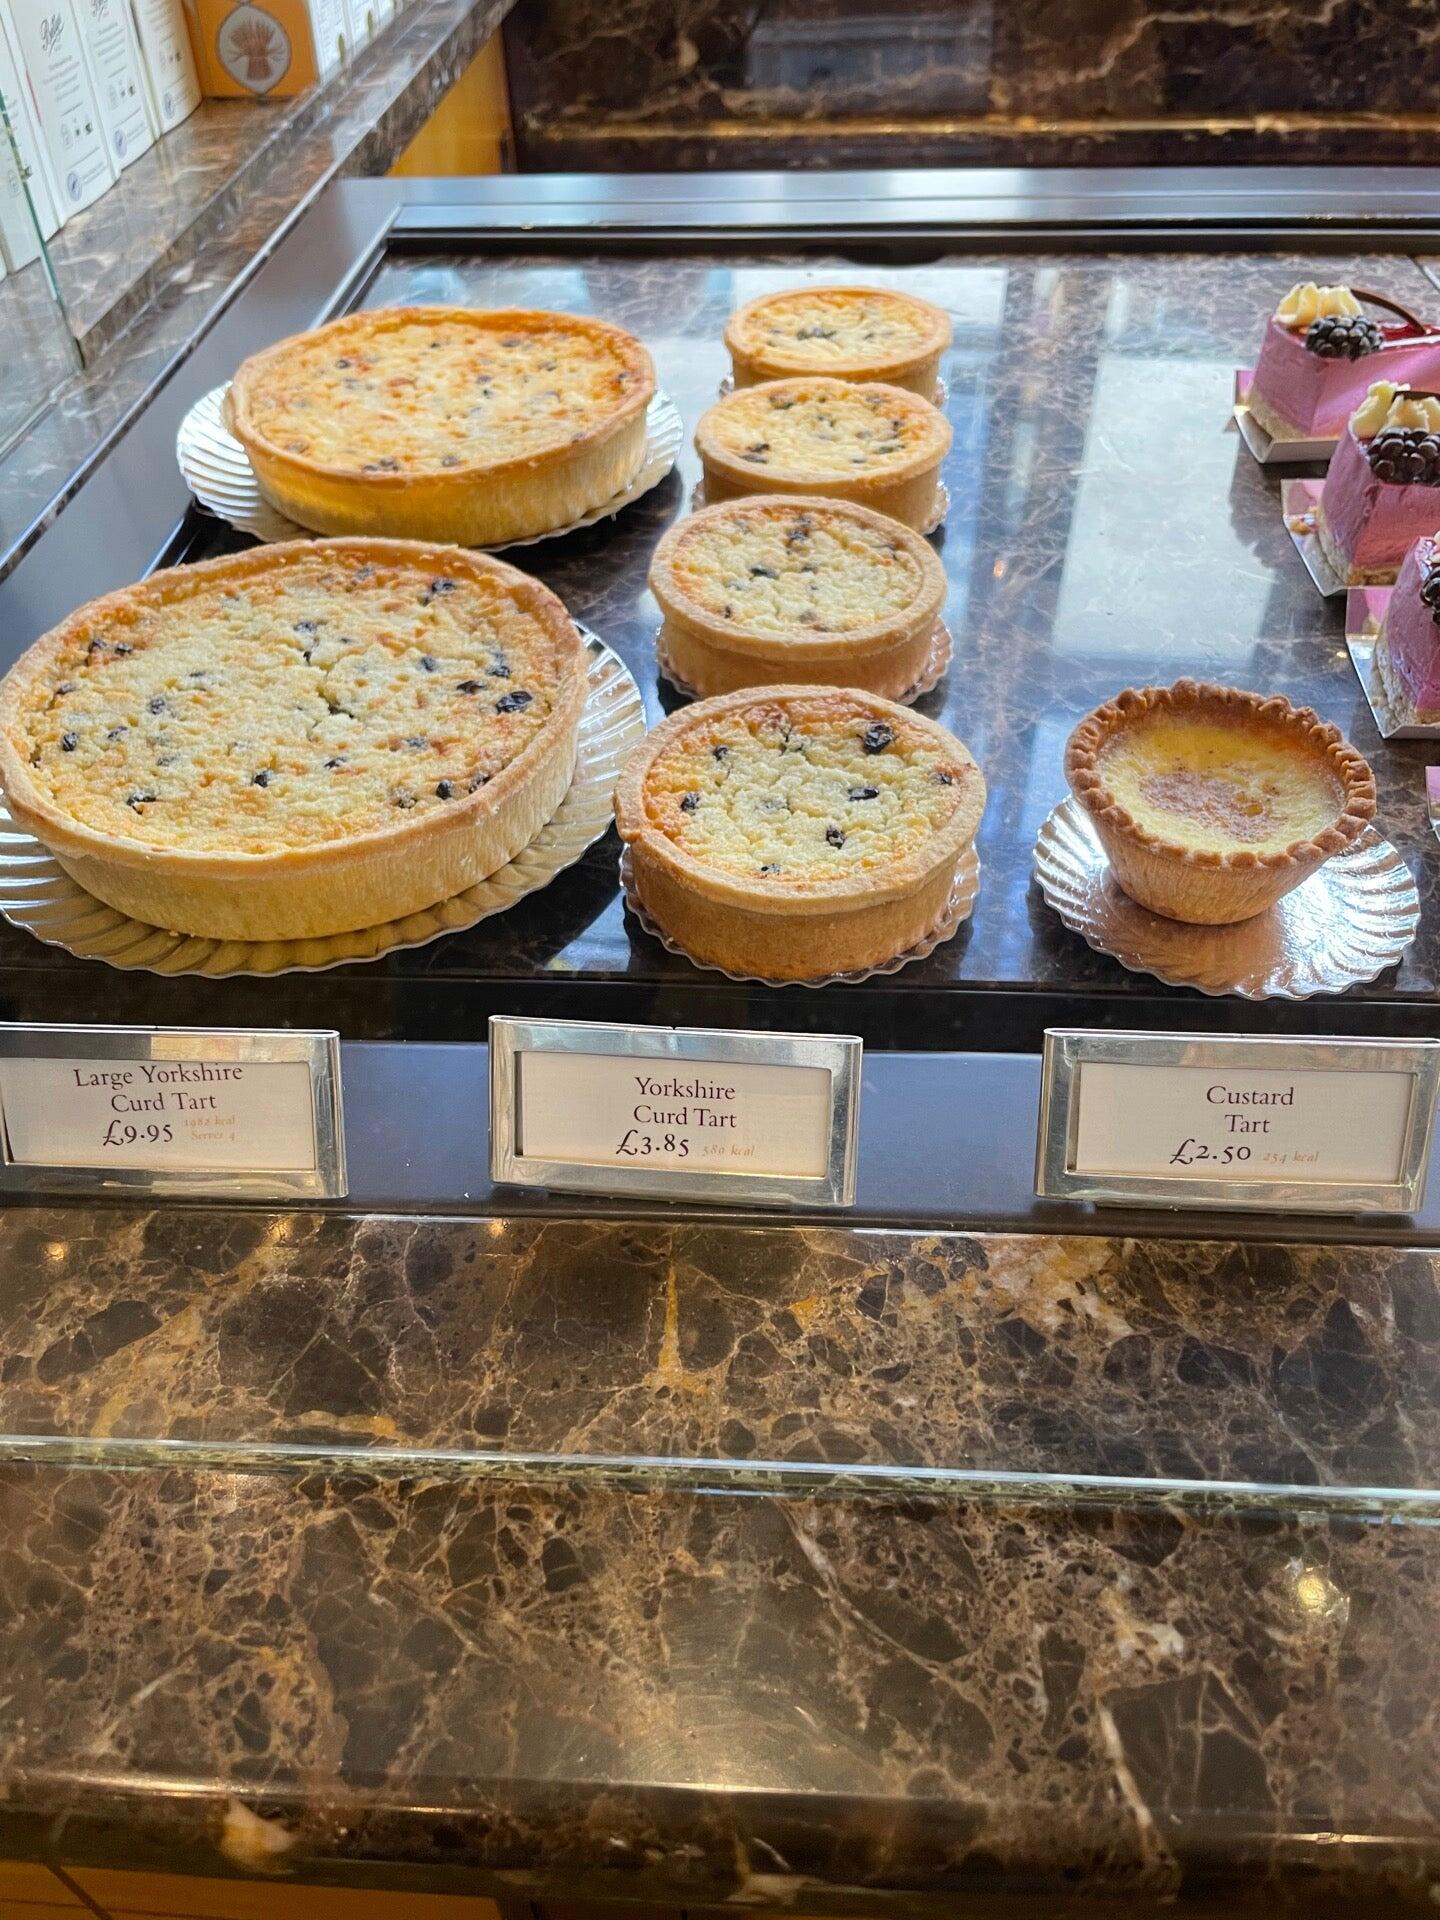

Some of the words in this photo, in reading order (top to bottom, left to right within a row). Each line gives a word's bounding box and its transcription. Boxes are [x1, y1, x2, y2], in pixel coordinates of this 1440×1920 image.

[73, 1068, 133, 1091] Large
[139, 1062, 243, 1084] Yorkshire
[634, 1076, 736, 1100] Yorkshire
[111, 1092, 165, 1113] Curd
[171, 1092, 217, 1110] Tart
[1206, 1085, 1294, 1106] Custard
[633, 1104, 688, 1126] Curd
[693, 1108, 737, 1128] Tart
[1224, 1114, 1271, 1133] Tart
[102, 1119, 173, 1146] £9.95
[615, 1129, 689, 1157] £3.85
[1169, 1138, 1251, 1165] £2.50
